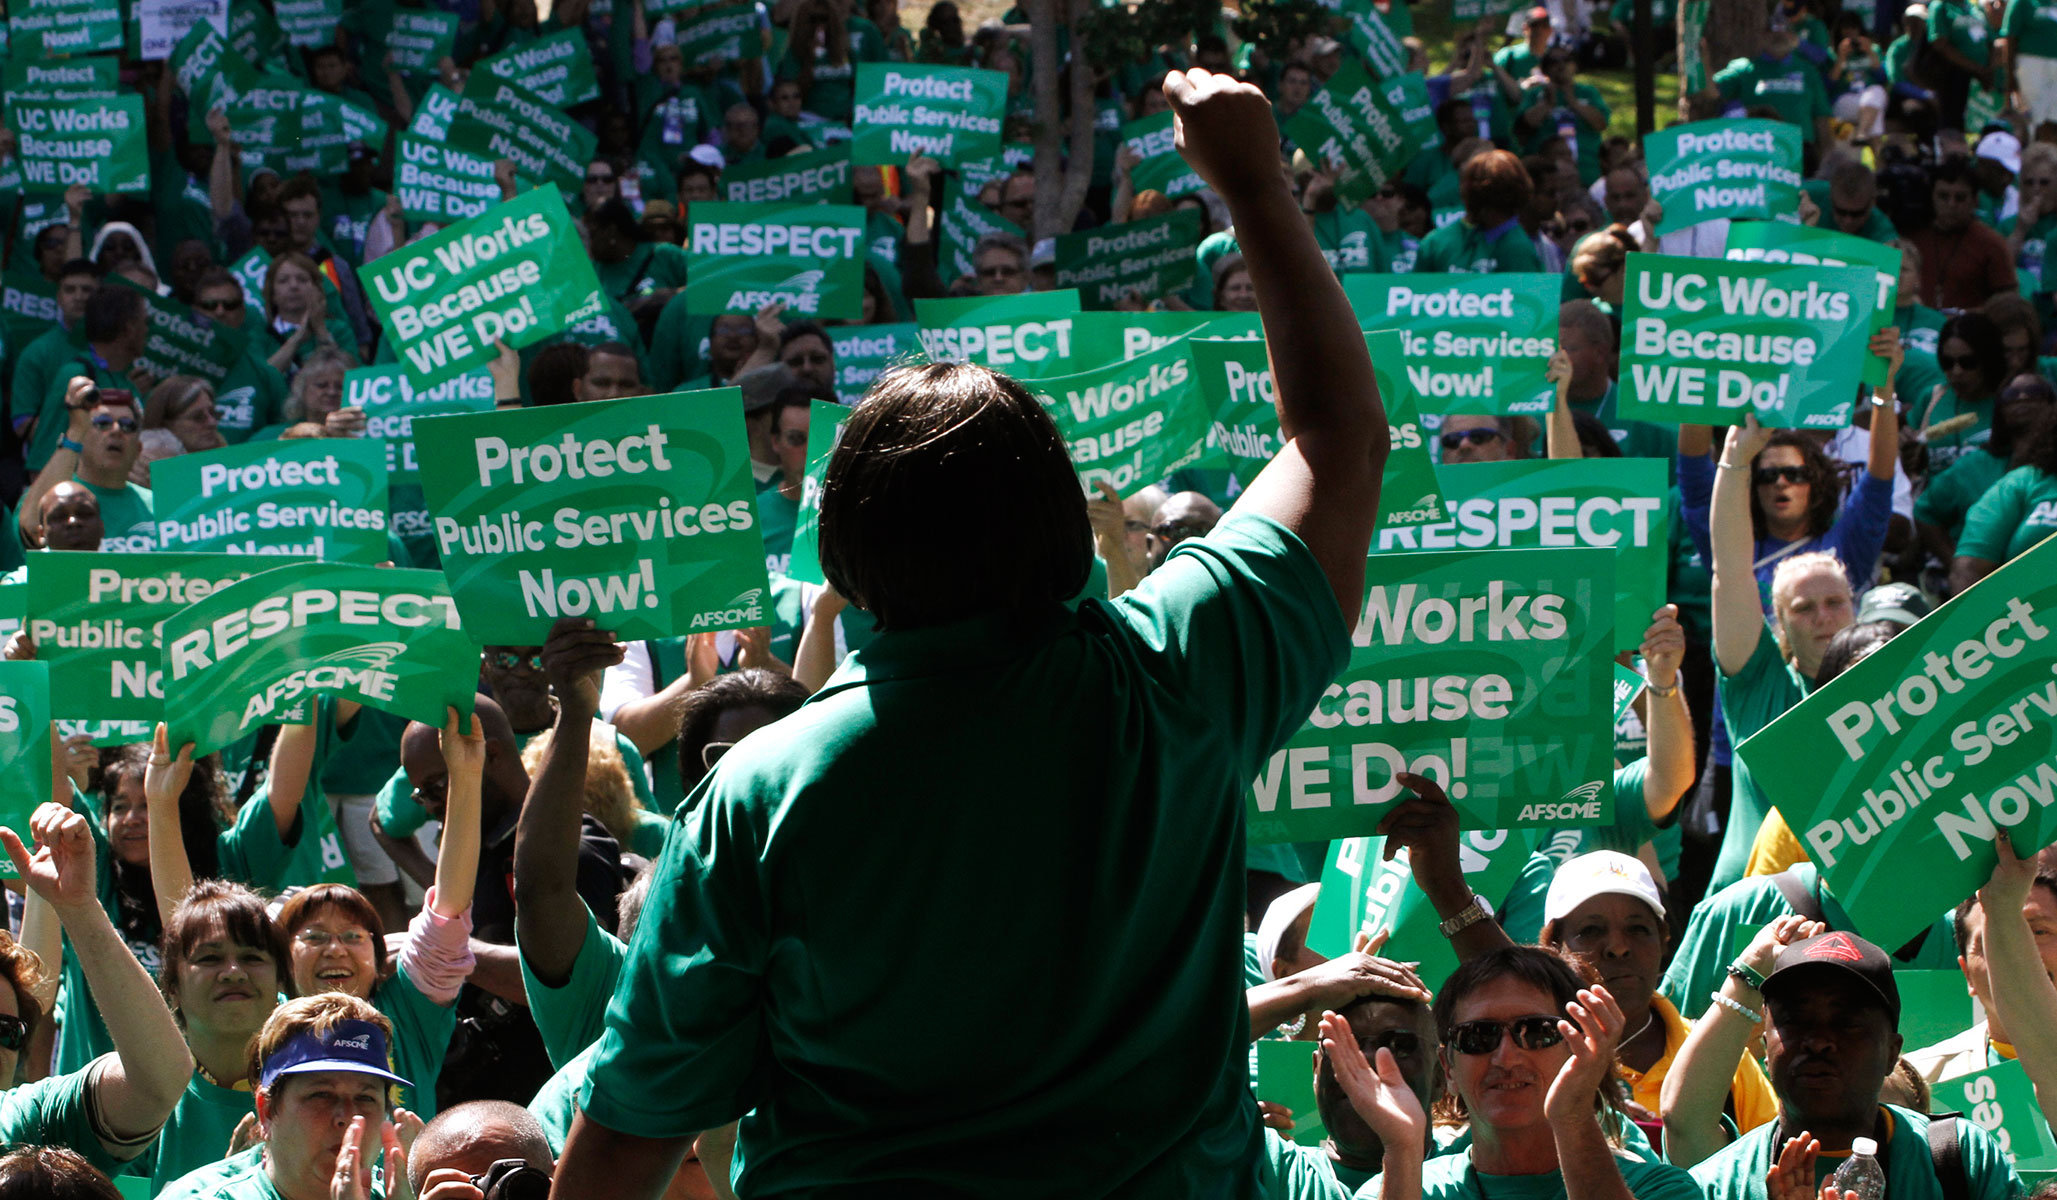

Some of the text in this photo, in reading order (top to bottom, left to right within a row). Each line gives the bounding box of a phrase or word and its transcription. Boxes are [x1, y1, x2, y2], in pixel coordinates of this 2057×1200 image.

[884, 72, 973, 101] Protect
[16, 105, 129, 132] UC Works
[495, 84, 571, 143] Protect
[854, 104, 1000, 134] Public Services
[1350, 86, 1402, 153] Protect
[20, 137, 112, 157] Because
[402, 140, 438, 165] UC
[459, 98, 515, 134] Public
[517, 125, 585, 178] Services
[489, 133, 546, 175] Now!
[890, 130, 954, 156] Now!
[1677, 129, 1775, 157] Protect
[23, 160, 57, 184] WE
[58, 161, 99, 185] Do!
[400, 164, 500, 199] Because
[728, 160, 849, 203] RESPECT
[1651, 160, 1801, 194] Public Services
[399, 187, 439, 213] WE
[1694, 184, 1766, 212] Now!
[373, 213, 550, 303] UC Works
[692, 223, 862, 259] RESPECT
[1087, 223, 1171, 257] Protect
[390, 259, 541, 342] Because
[726, 291, 820, 313] AFSCME
[1386, 286, 1514, 318] Protect
[1638, 271, 1708, 313] UC
[1718, 276, 1850, 321] Works
[144, 297, 215, 348] rotect
[405, 295, 538, 375] WE Do!
[920, 318, 1073, 365] RESPECT
[1433, 330, 1556, 357] Services
[1635, 317, 1817, 366] Because
[350, 374, 392, 408] UC
[1066, 358, 1190, 424] Works
[1406, 365, 1494, 398] Now!
[1631, 364, 1790, 411] WE Do!
[475, 424, 672, 487] Protect
[1068, 411, 1165, 463] ause
[1219, 421, 1274, 460] Public
[200, 455, 341, 498] Protect
[159, 500, 385, 548] Public Services
[435, 497, 753, 556] Public Services
[1387, 508, 1441, 524] AFSCME
[519, 558, 660, 619] Now!
[31, 619, 144, 649] Public
[171, 588, 462, 681] RESPECT
[690, 606, 763, 629] AFSCME
[1350, 580, 1567, 648] Works
[238, 665, 399, 731] AFSCME
[1309, 673, 1513, 729] cause
[1825, 597, 2050, 762] Protect
[1351, 737, 1467, 805] Do!
[1804, 662, 2057, 868] Public Serv
[1517, 801, 1602, 822] AFSCME
[1933, 754, 2057, 862] Now
